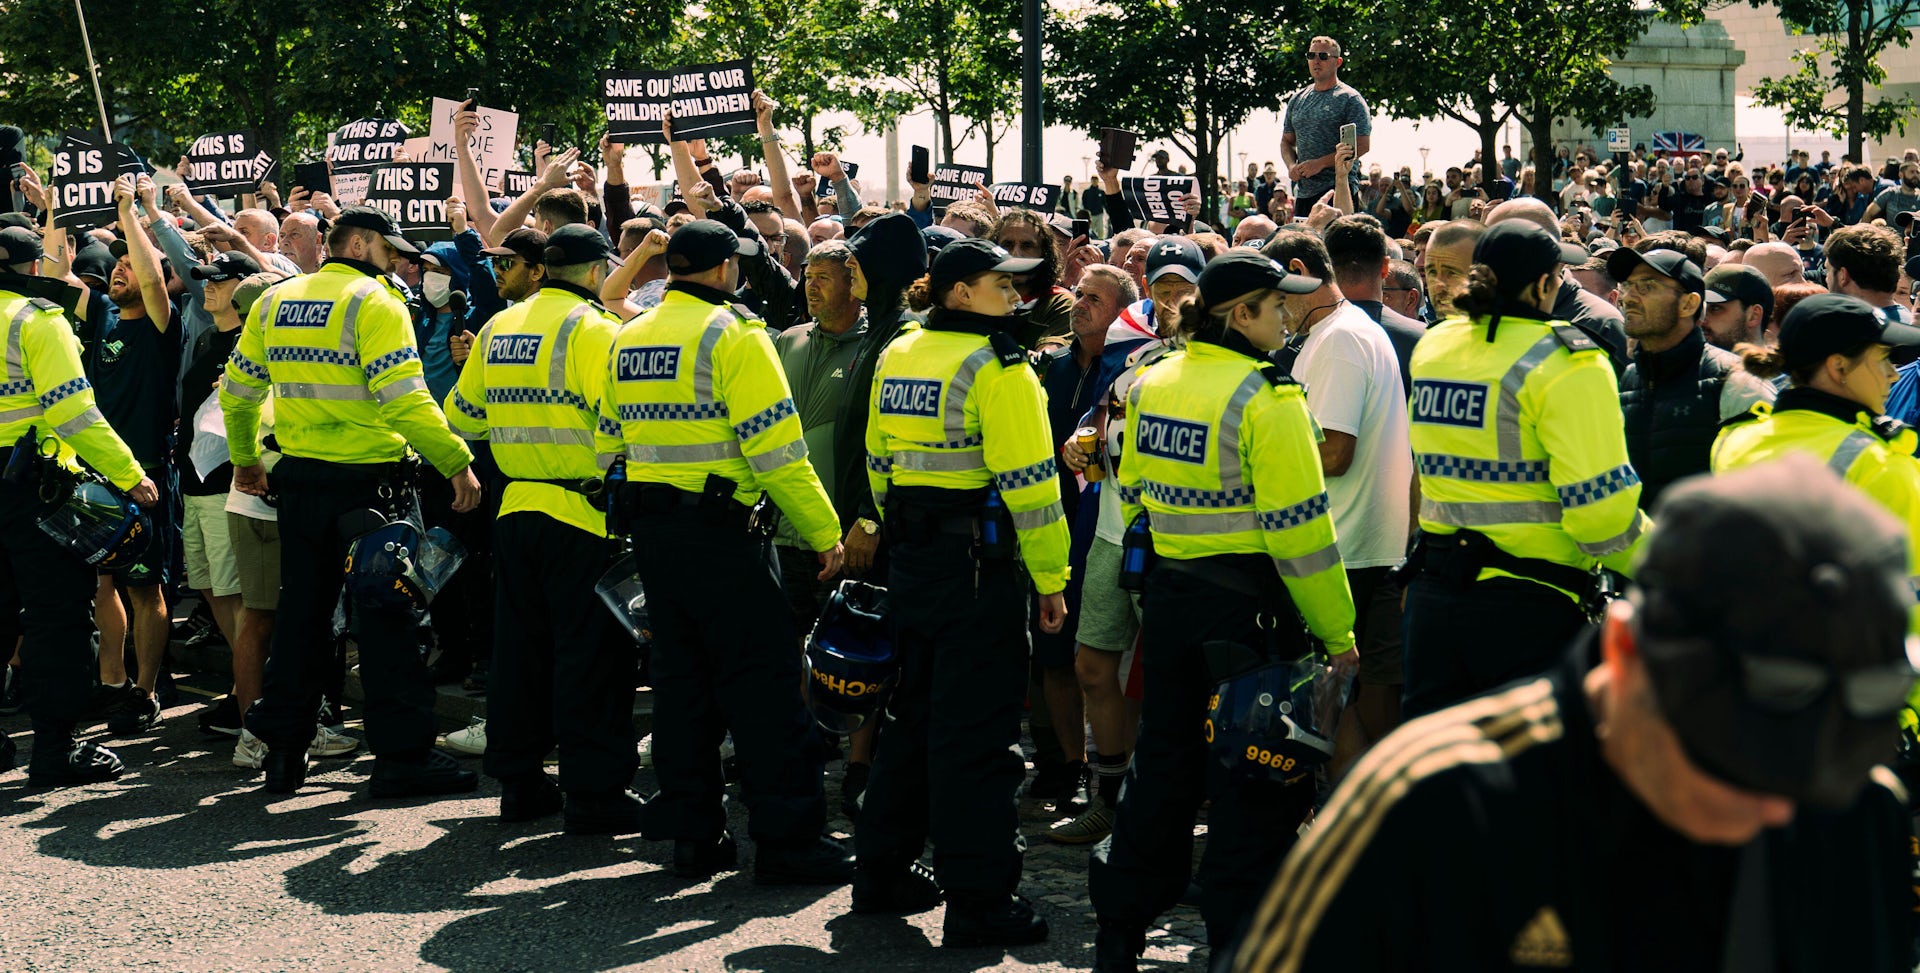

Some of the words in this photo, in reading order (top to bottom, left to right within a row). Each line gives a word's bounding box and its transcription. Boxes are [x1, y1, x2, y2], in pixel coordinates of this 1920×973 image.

[606, 79, 643, 97] SAVE
[646, 79, 671, 98] OU
[672, 73, 707, 94] SAVE
[709, 68, 746, 90] OUR
[606, 103, 670, 121] CHILDRE
[671, 92, 750, 119] CHILDREN
[343, 121, 378, 140] THIS
[380, 122, 400, 138] IS
[191, 136, 225, 156] THIS
[228, 134, 245, 154] IS
[331, 143, 361, 162] OUR
[364, 142, 402, 160] CITY
[433, 141, 483, 166] MEA
[78, 150, 103, 174] IS
[221, 160, 253, 180] CITY
[376, 167, 414, 191] THIS
[420, 168, 439, 192] IS
[935, 168, 960, 183] SAVE
[961, 170, 985, 185] OUR
[64, 181, 116, 207] CITY
[993, 184, 1027, 202] THIS
[1029, 186, 1049, 206] IS
[1143, 179, 1170, 219] DREN
[407, 199, 448, 223] CITY
[277, 303, 331, 324] POLICE
[489, 338, 539, 360] POLICE
[619, 351, 677, 377] POLICE
[881, 383, 938, 412] POLICE
[1413, 385, 1483, 422] POLICE
[1137, 420, 1204, 458] POLICE
